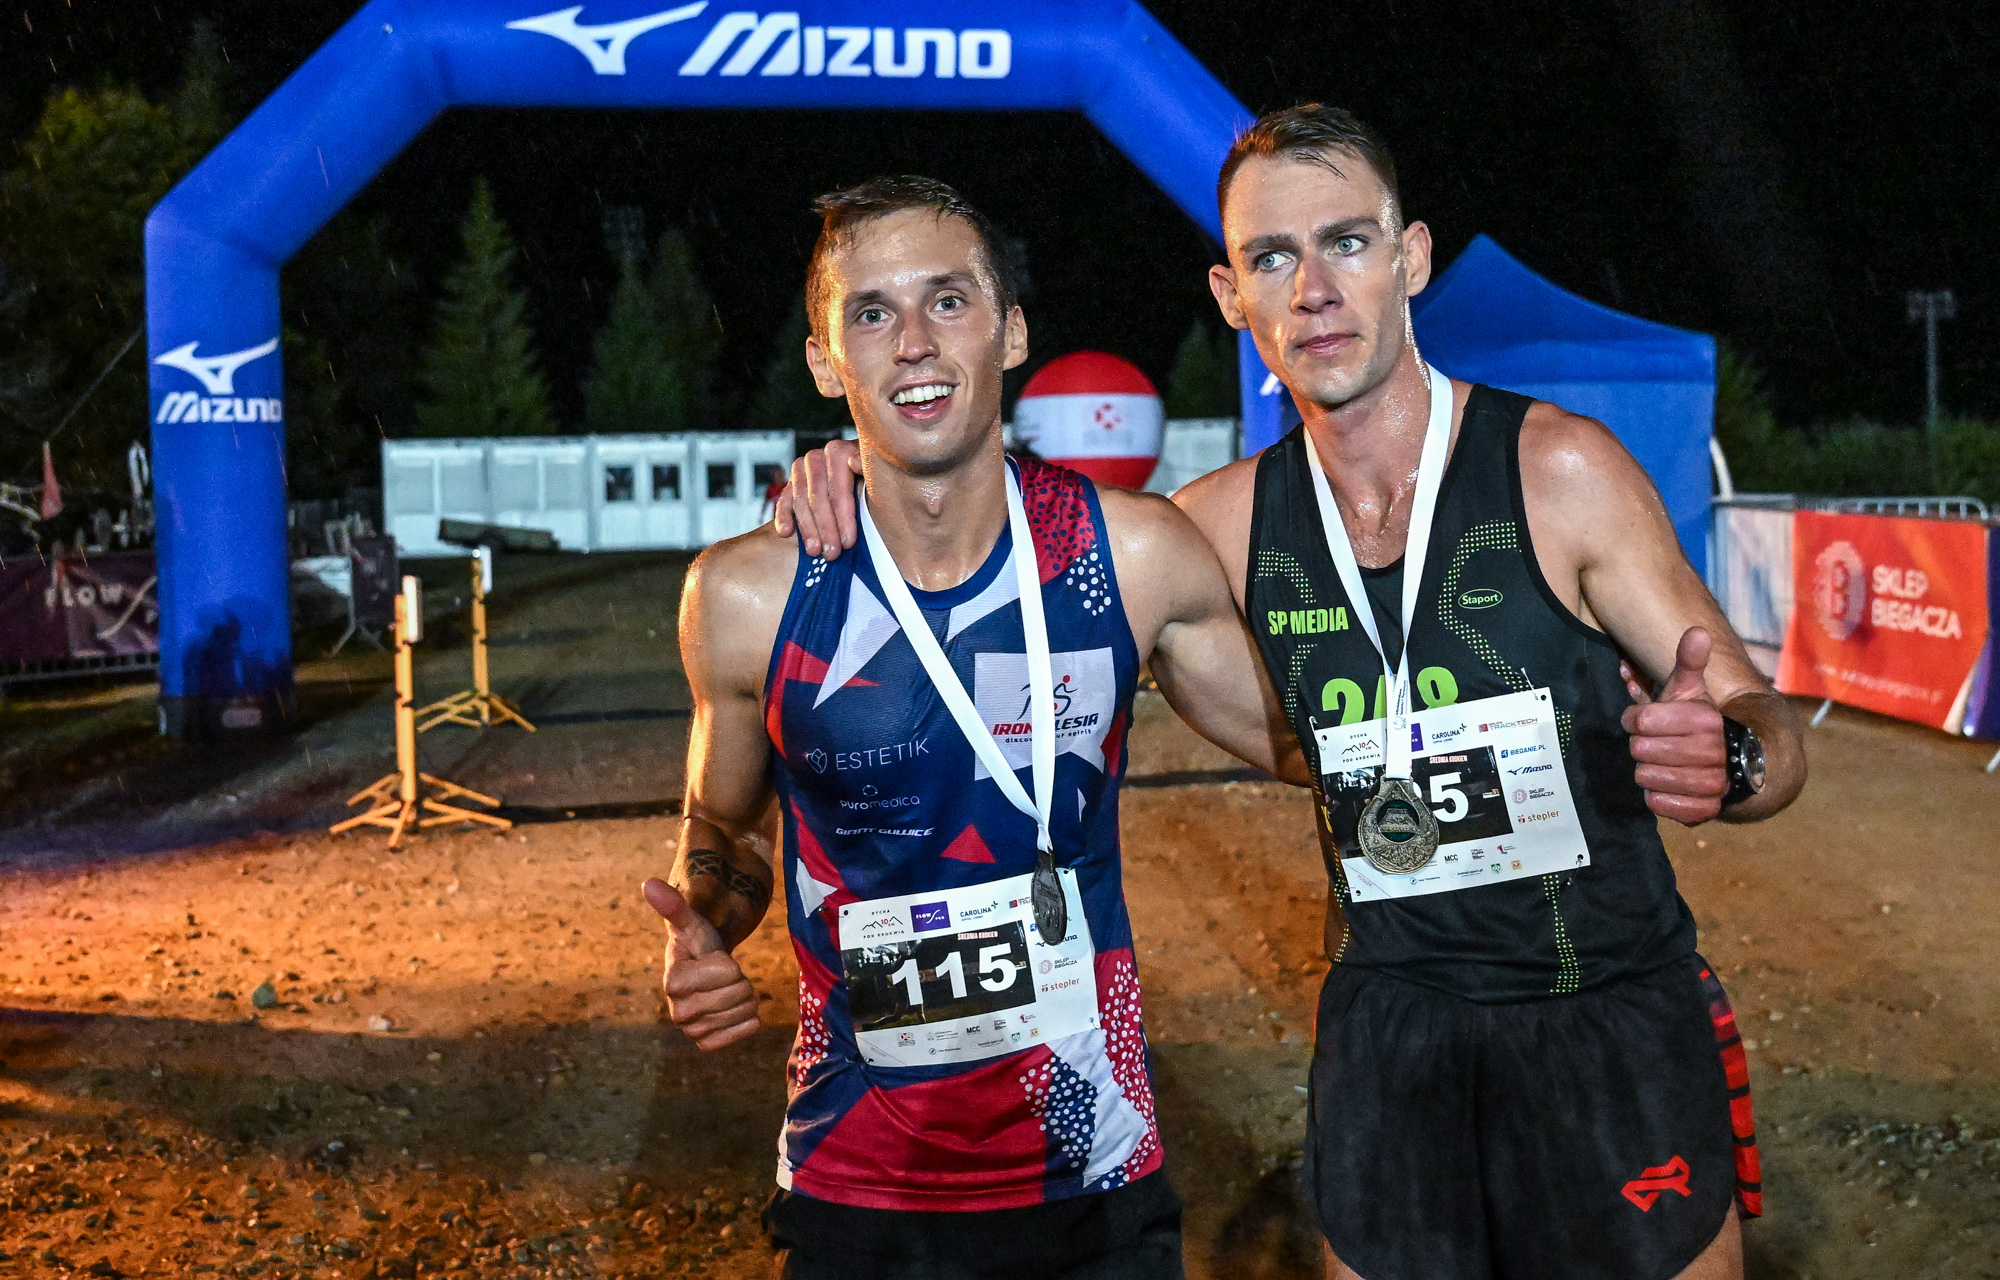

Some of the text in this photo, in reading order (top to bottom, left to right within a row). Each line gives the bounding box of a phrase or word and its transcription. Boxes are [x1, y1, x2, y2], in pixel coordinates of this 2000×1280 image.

[678, 11, 1011, 79] MIZUNO
[155, 391, 283, 425] MIZUNO
[1872, 564, 1929, 600] SKLEP
[1461, 592, 1499, 606] Staport
[1267, 607, 1349, 635] SP MEDIA
[1871, 598, 1962, 640] BIEGACZA
[1068, 729, 1092, 737] spirit
[1431, 729, 1460, 740] CAROLINA
[836, 738, 930, 771] ESTETIK
[1510, 744, 1546, 756] BIEGANIE.PL
[1521, 764, 1553, 774] MIZUNO
[1528, 787, 1545, 795] SKLEP
[1530, 790, 1555, 800] BIEGACZA
[839, 795, 921, 811] puromedica
[1527, 810, 1560, 824] stepler
[1444, 854, 1458, 864] MCC
[915, 912, 931, 920] FLOW
[959, 906, 992, 918] CAROLINA
[880, 918, 889, 926] 10
[1054, 957, 1070, 965] SKLEP
[892, 942, 1017, 1006] 115
[1050, 978, 1080, 992] stepler
[966, 1025, 981, 1034] MCC
